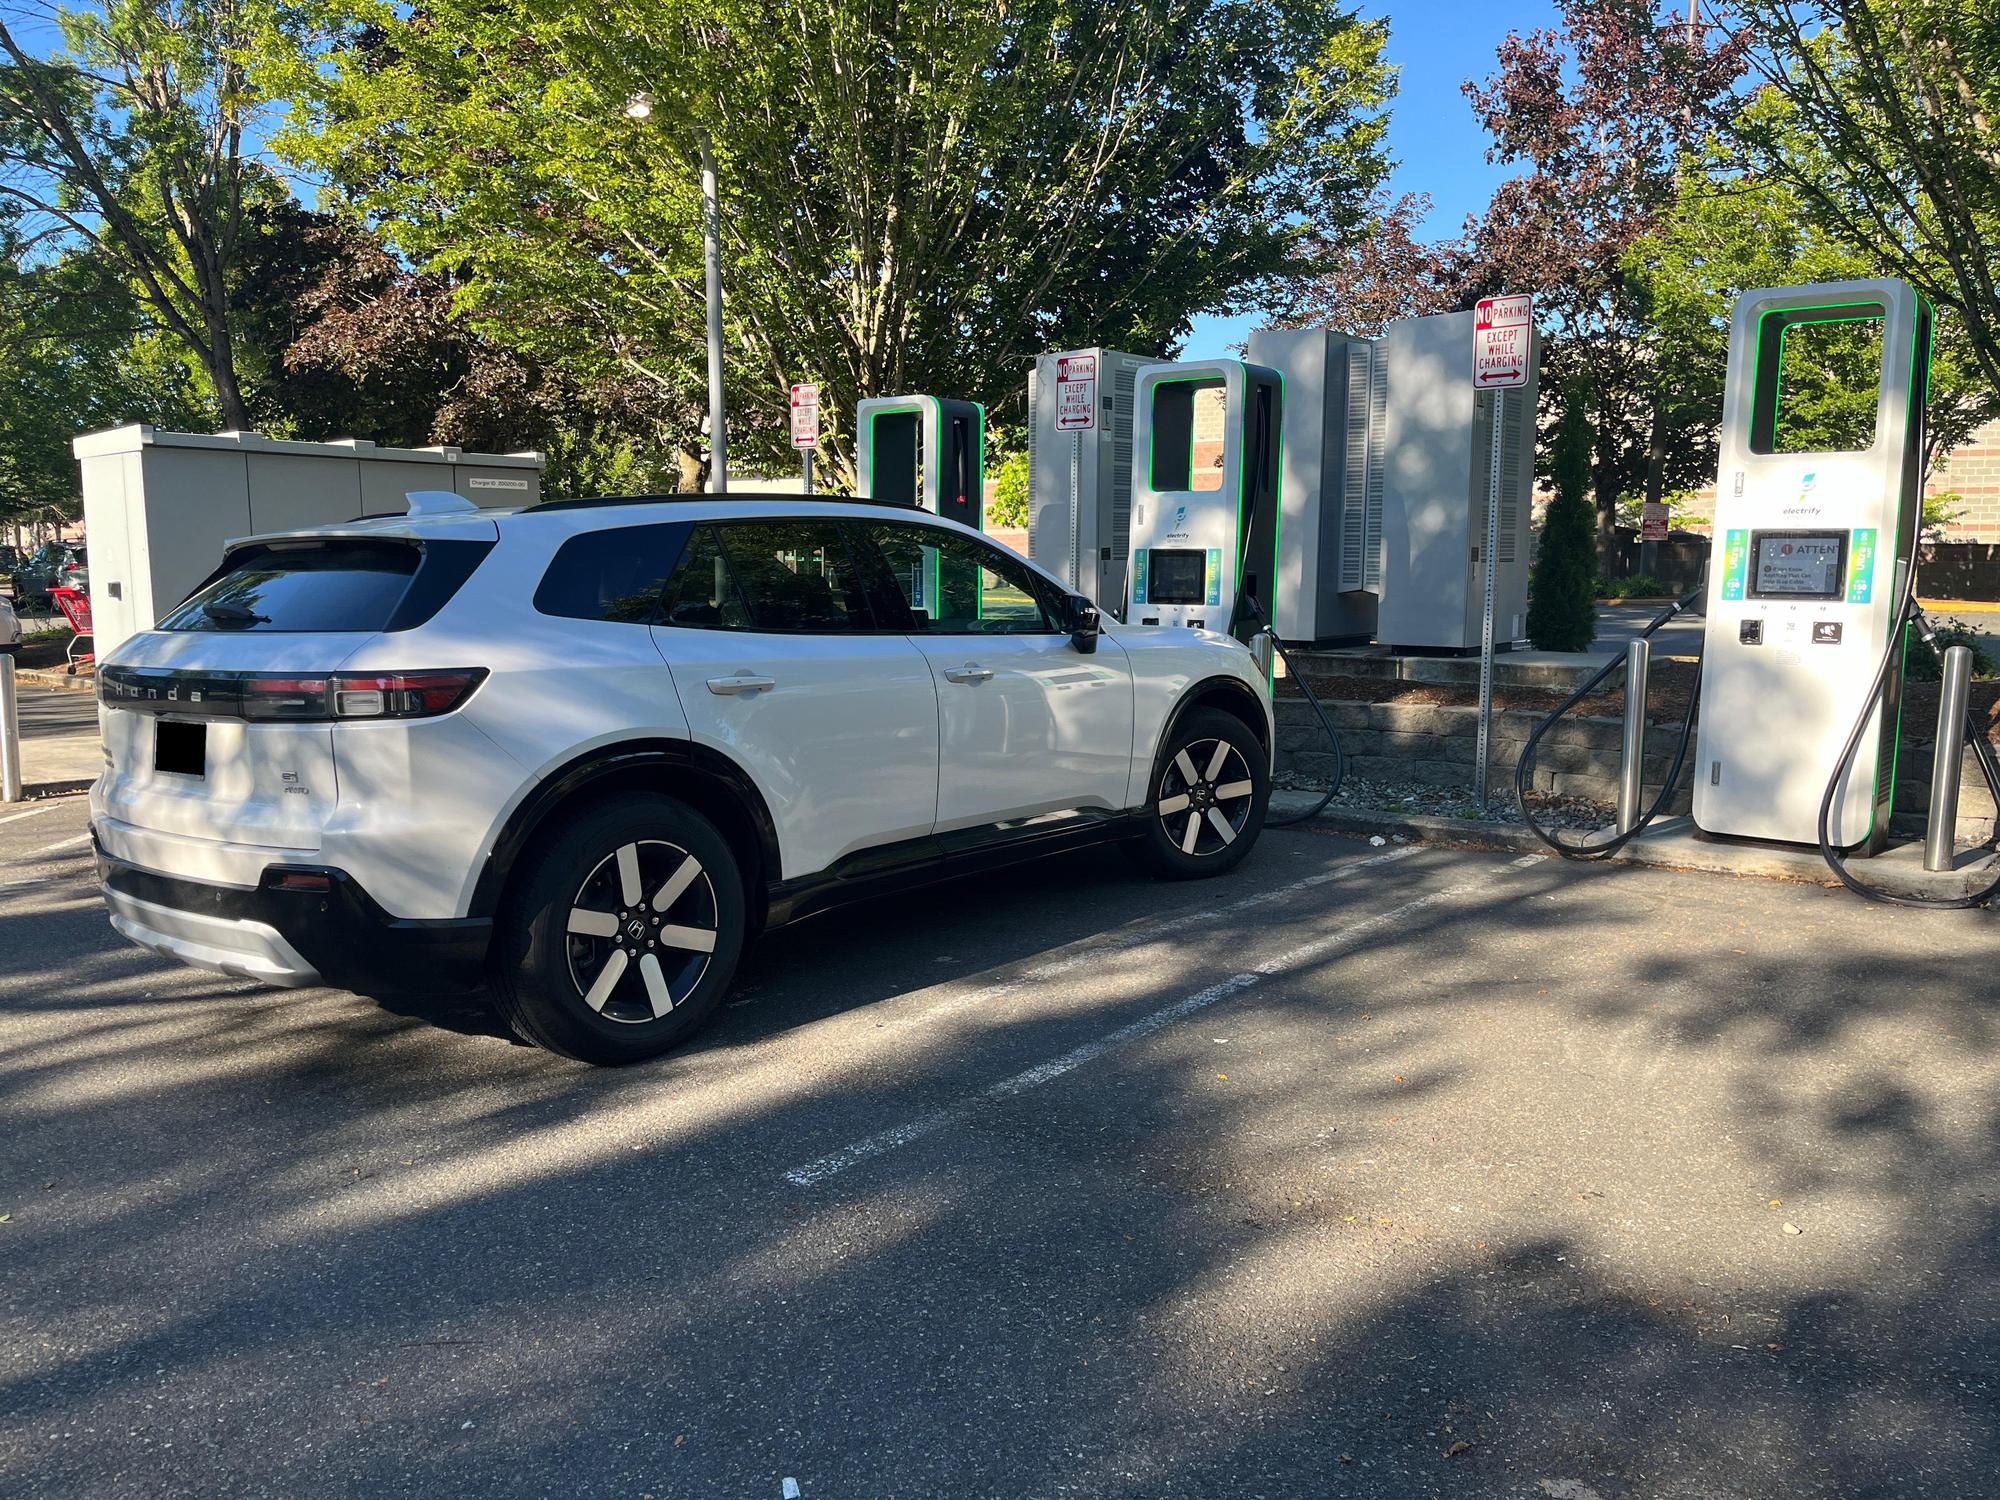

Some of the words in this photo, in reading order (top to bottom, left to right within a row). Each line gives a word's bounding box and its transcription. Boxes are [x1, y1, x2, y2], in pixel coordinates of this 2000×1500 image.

[1477, 307, 1491, 324] NO
[1493, 305, 1528, 319] PARKING
[1487, 329, 1518, 343] EXCEPT
[1488, 343, 1514, 355] WHILE
[1479, 355, 1523, 370] CHARGING
[1057, 364, 1068, 378] NO
[1069, 363, 1094, 373] PARKING
[1065, 383, 1087, 394] EXCEPT
[1066, 394, 1085, 404] WHILE
[797, 407, 812, 416] EXCEPT
[1060, 405, 1091, 415] CHARGING
[798, 416, 811, 425] WHILE
[795, 425, 815, 434] CHARGING
[1783, 507, 1822, 516] electrify
[1729, 546, 1740, 570] Ultra
[1855, 546, 1867, 571] Ultra
[1853, 583, 1868, 591] 150
[115, 682, 202, 702] Honda
